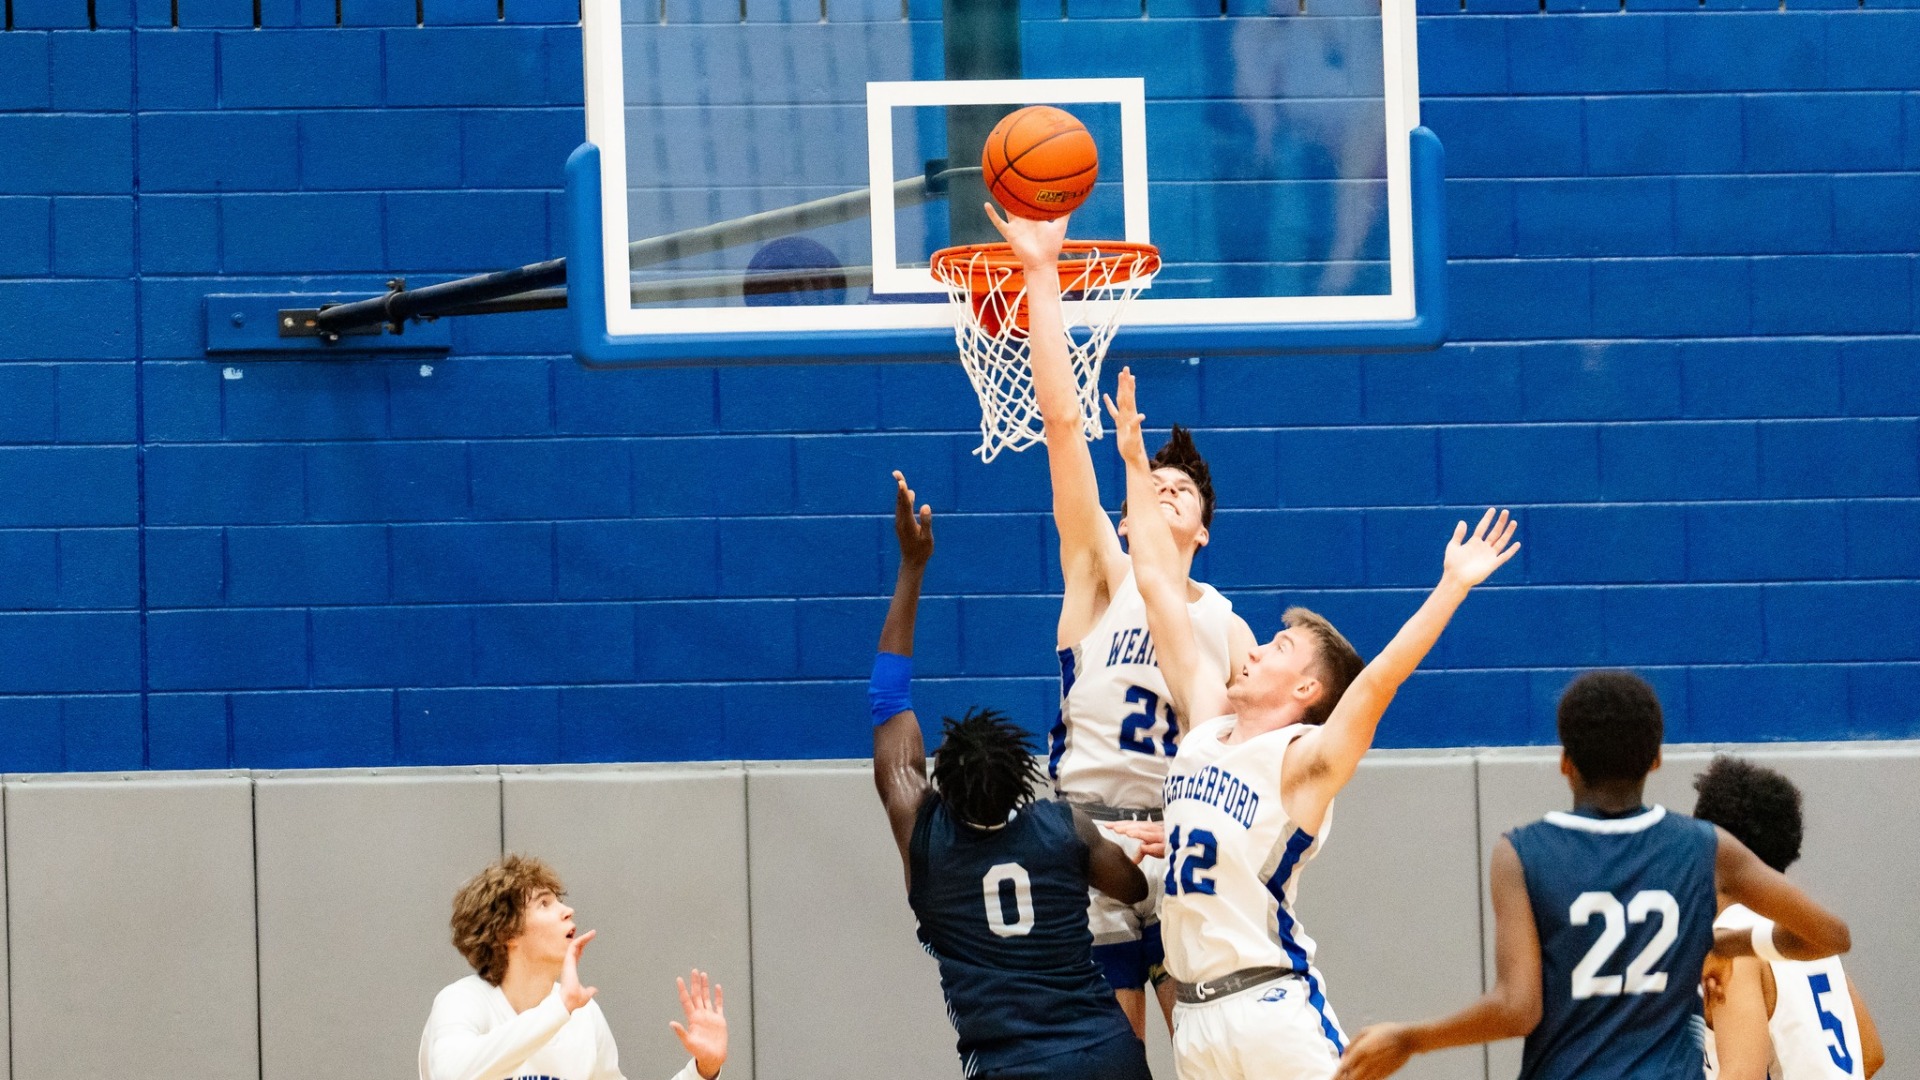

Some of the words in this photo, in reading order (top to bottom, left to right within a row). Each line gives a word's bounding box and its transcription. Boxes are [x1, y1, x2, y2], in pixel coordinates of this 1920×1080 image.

[1106, 627, 1158, 667] WEA
[1119, 684, 1179, 757] 21
[1165, 825, 1218, 896] 12
[982, 862, 1035, 938] 0
[1569, 889, 1680, 999] 22
[1807, 973, 1854, 1075] 5
